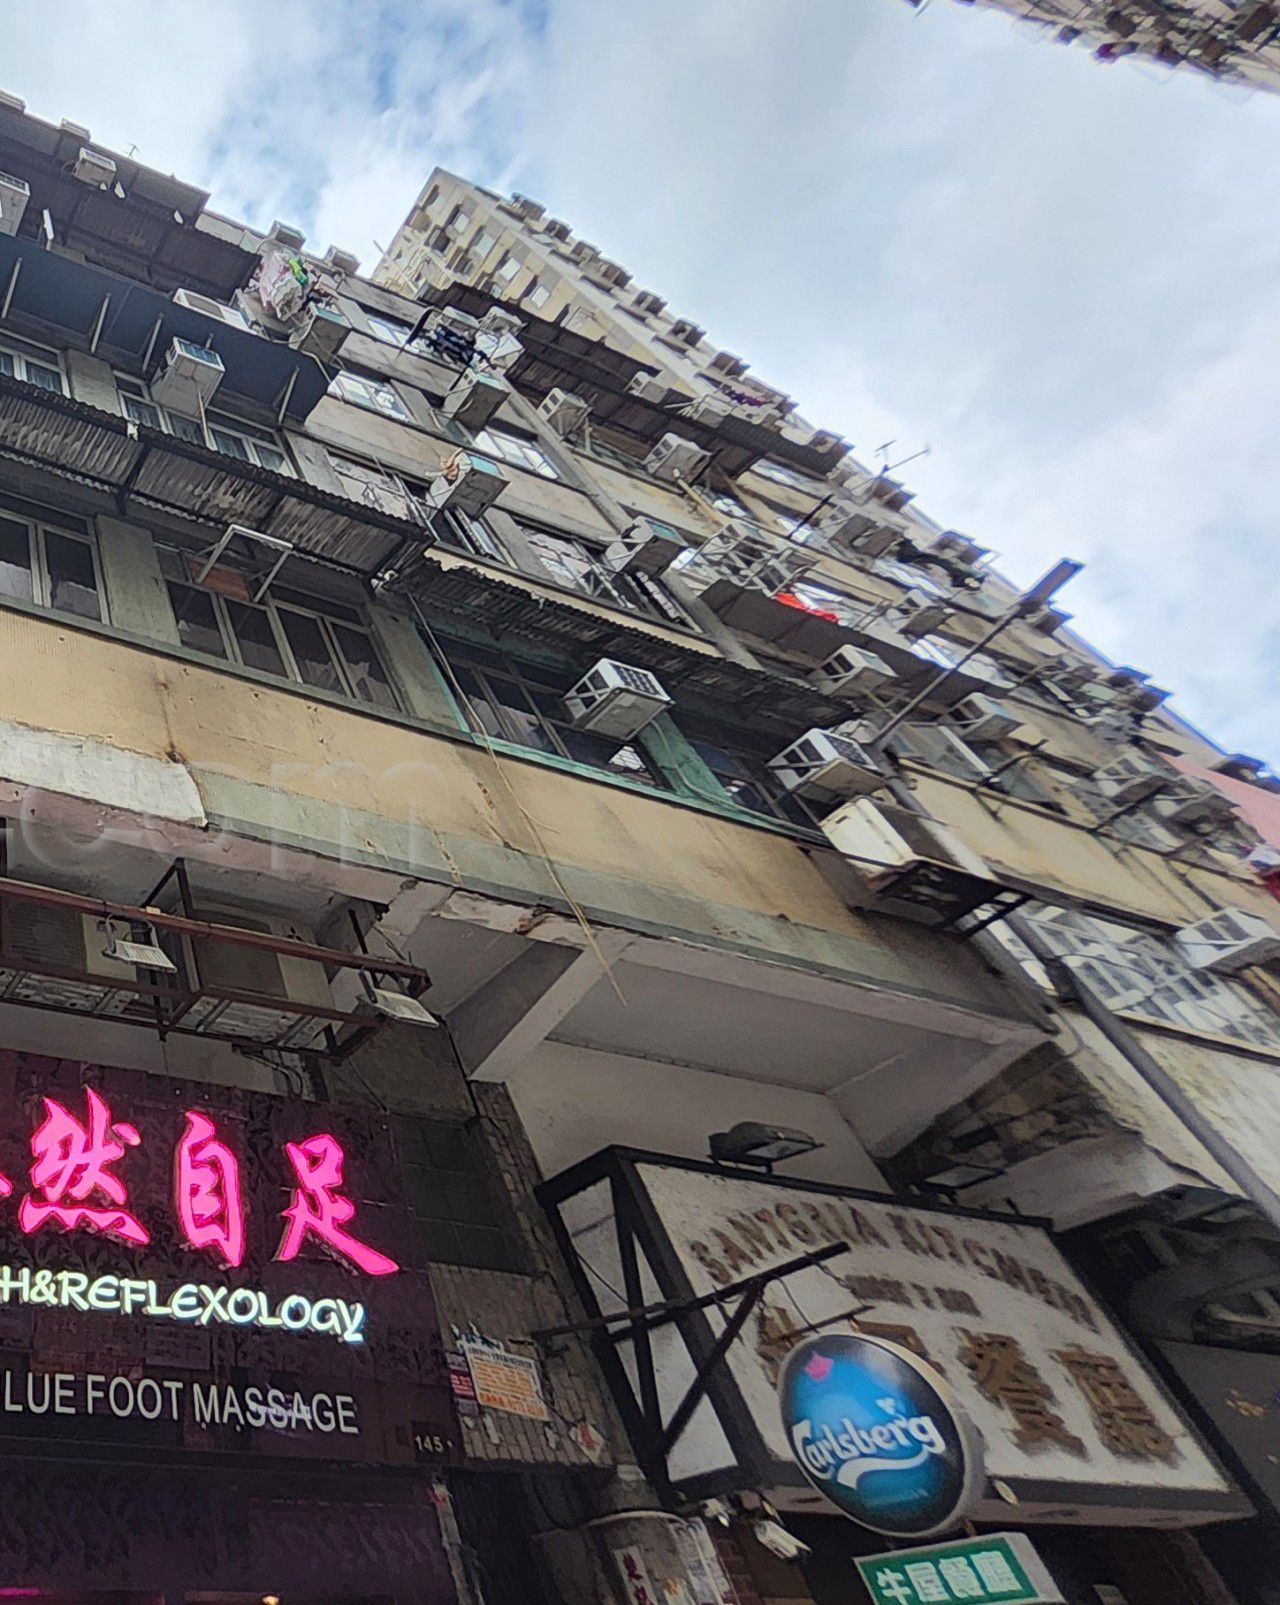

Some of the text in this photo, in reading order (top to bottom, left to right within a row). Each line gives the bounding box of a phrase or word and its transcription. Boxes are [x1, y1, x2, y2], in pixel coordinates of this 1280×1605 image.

[86, 1374, 184, 1421] FOOT
[193, 1383, 360, 1435] MASSAGE
[791, 1411, 947, 1481] Carlsberg
